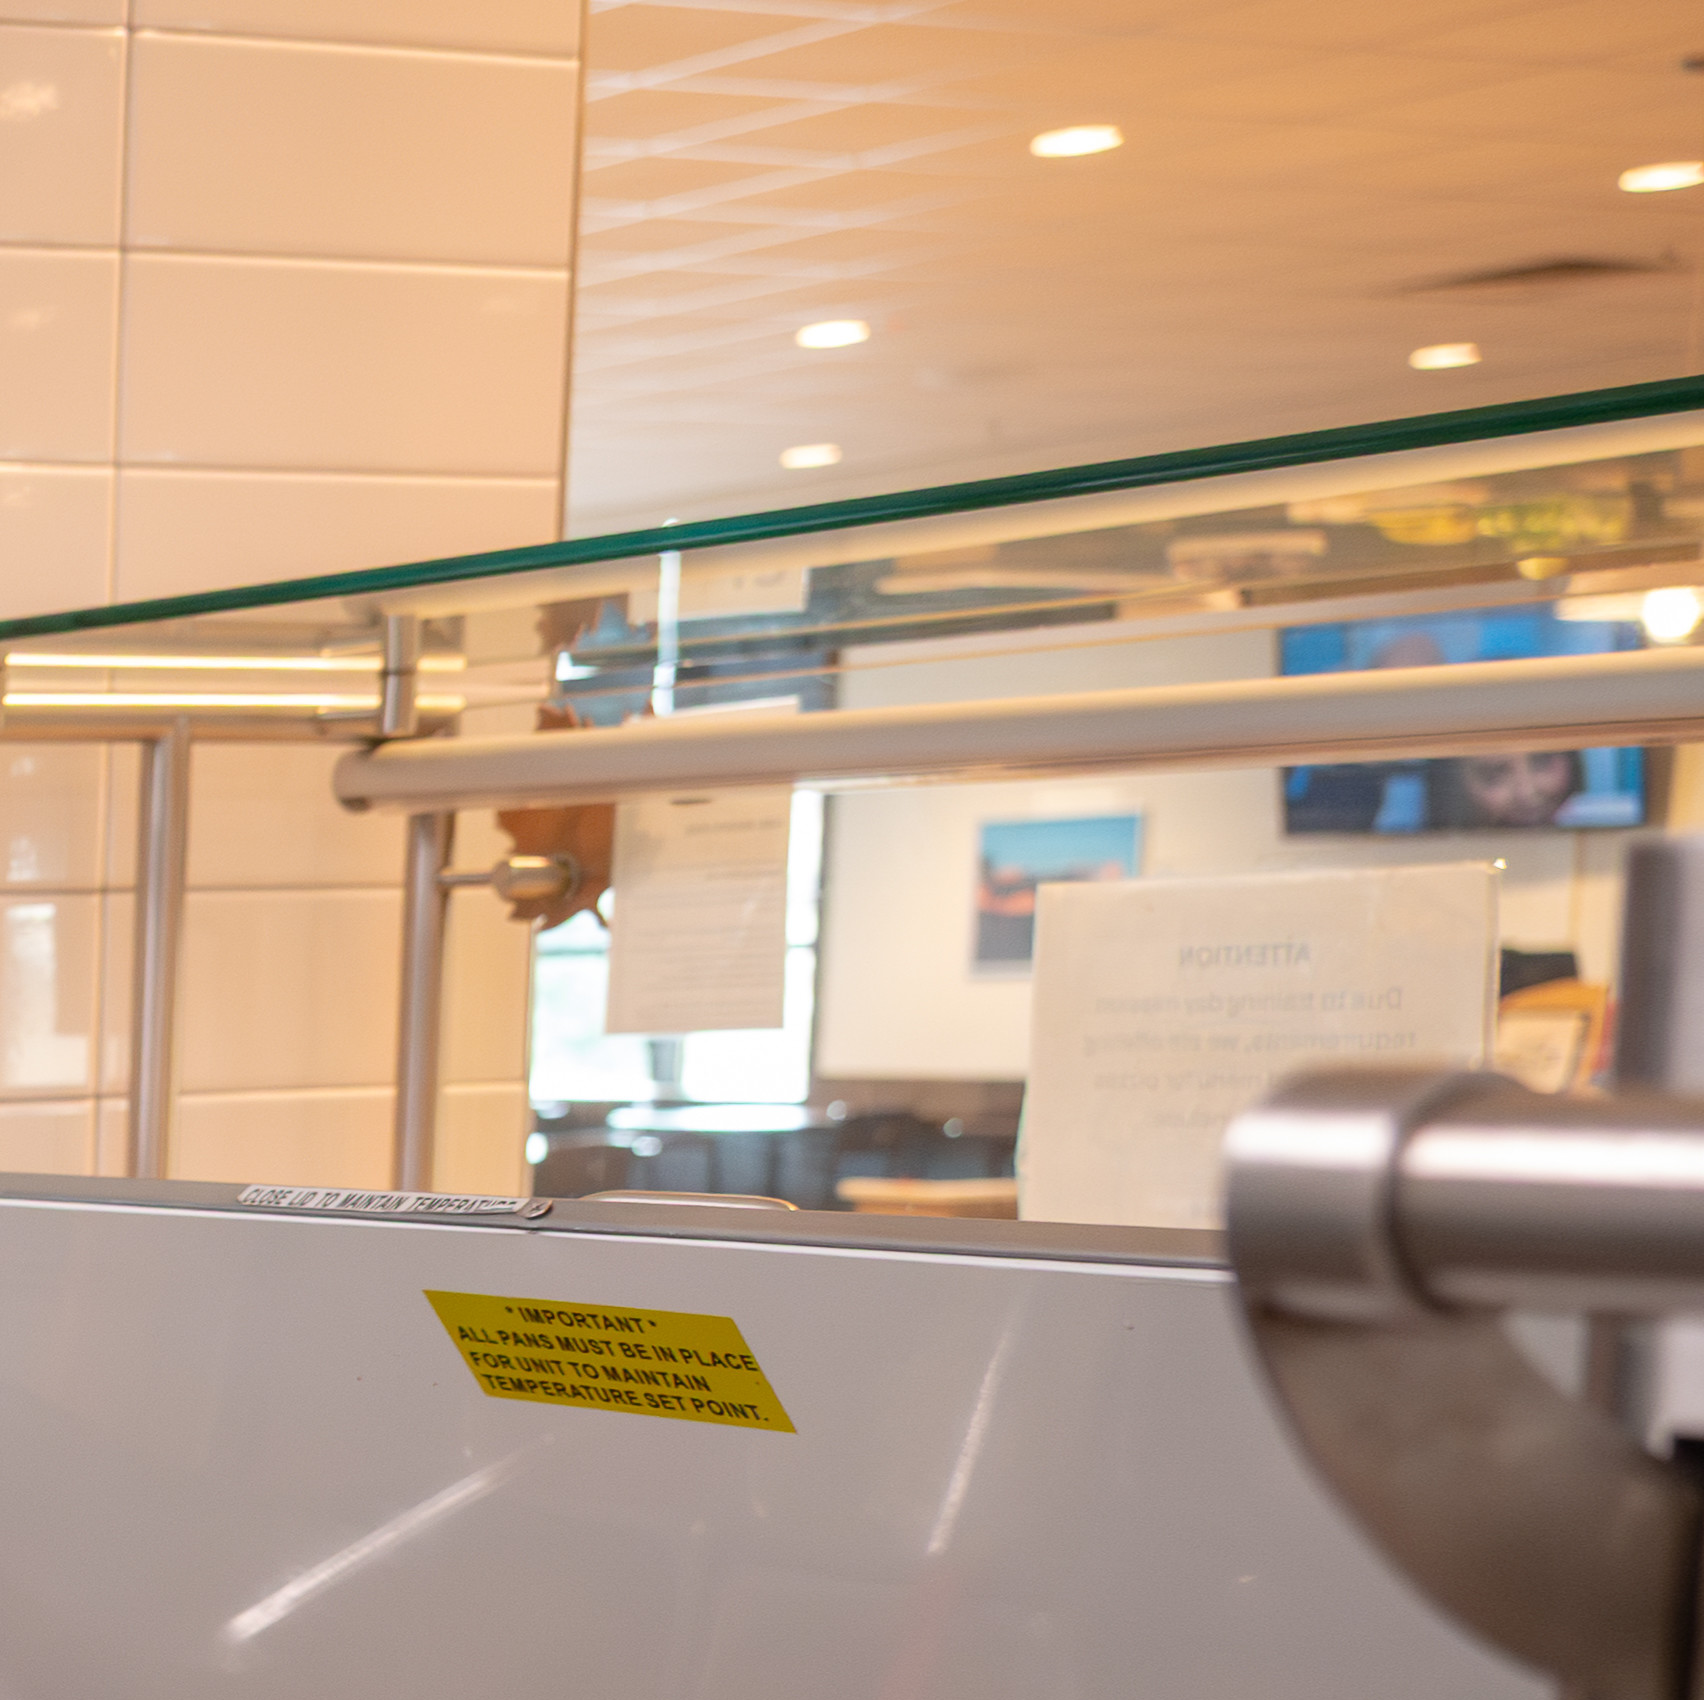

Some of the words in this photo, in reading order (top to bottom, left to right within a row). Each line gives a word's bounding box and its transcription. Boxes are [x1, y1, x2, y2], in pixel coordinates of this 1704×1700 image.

[242, 1188, 293, 1205] CLOSE
[314, 1192, 341, 1208] TO
[336, 1193, 410, 1210] MAINTAIN
[518, 1306, 645, 1334] IMPORTANT
[457, 1325, 499, 1344] ALL
[496, 1330, 555, 1350] PANS
[555, 1335, 616, 1357] MUST
[618, 1342, 653, 1361] BE
[651, 1344, 679, 1363] IN
[678, 1348, 759, 1372] PLACE
[469, 1351, 516, 1370] FOR
[515, 1356, 566, 1377] UNIT
[567, 1361, 600, 1380] TO
[601, 1365, 713, 1393] MAINTAIN
[480, 1373, 644, 1407] TEMPERATURE
[643, 1391, 687, 1412] SET
[690, 1397, 771, 1422] POINT.
